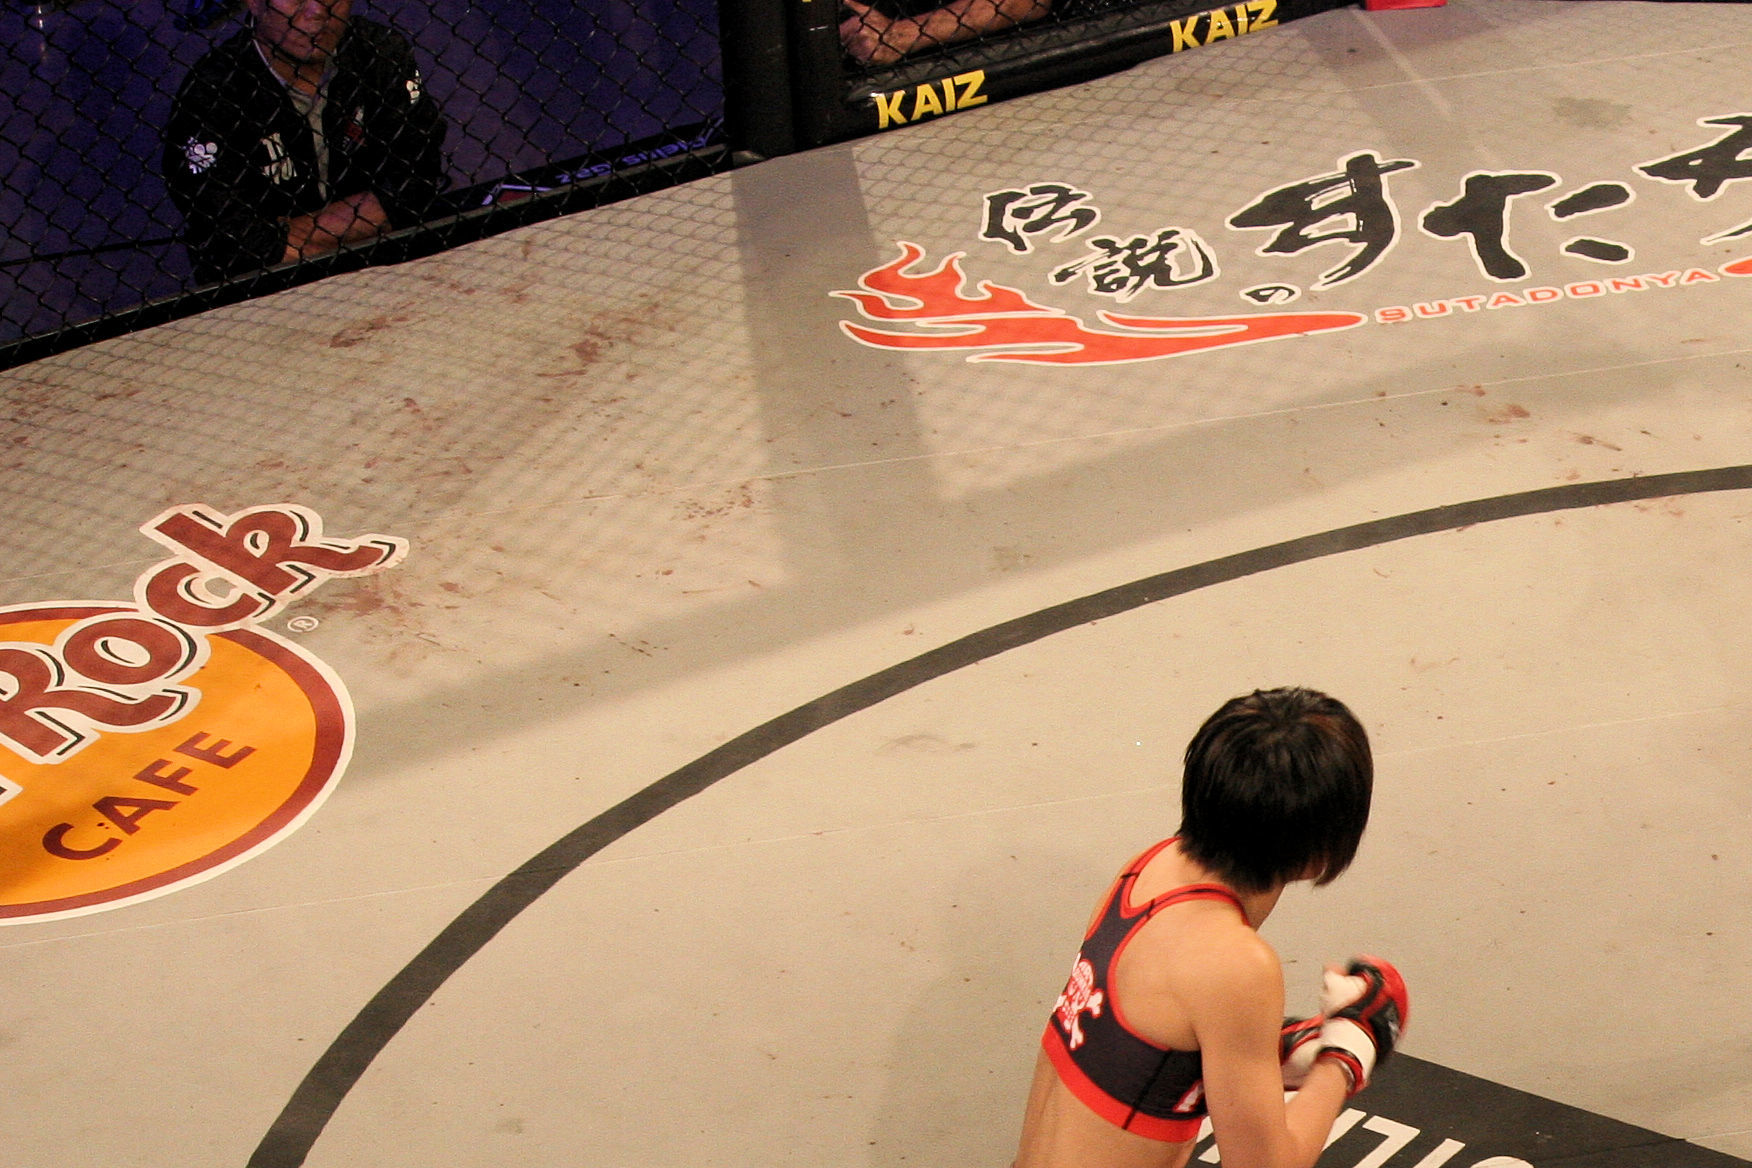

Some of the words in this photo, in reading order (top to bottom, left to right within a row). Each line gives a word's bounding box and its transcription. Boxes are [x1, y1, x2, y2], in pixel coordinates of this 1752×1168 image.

[1169, 0, 1279, 53] KAIZ
[876, 70, 988, 129] KAIZ
[1376, 267, 1717, 325] SUTADONYA
[42, 732, 257, 861] CAFE
